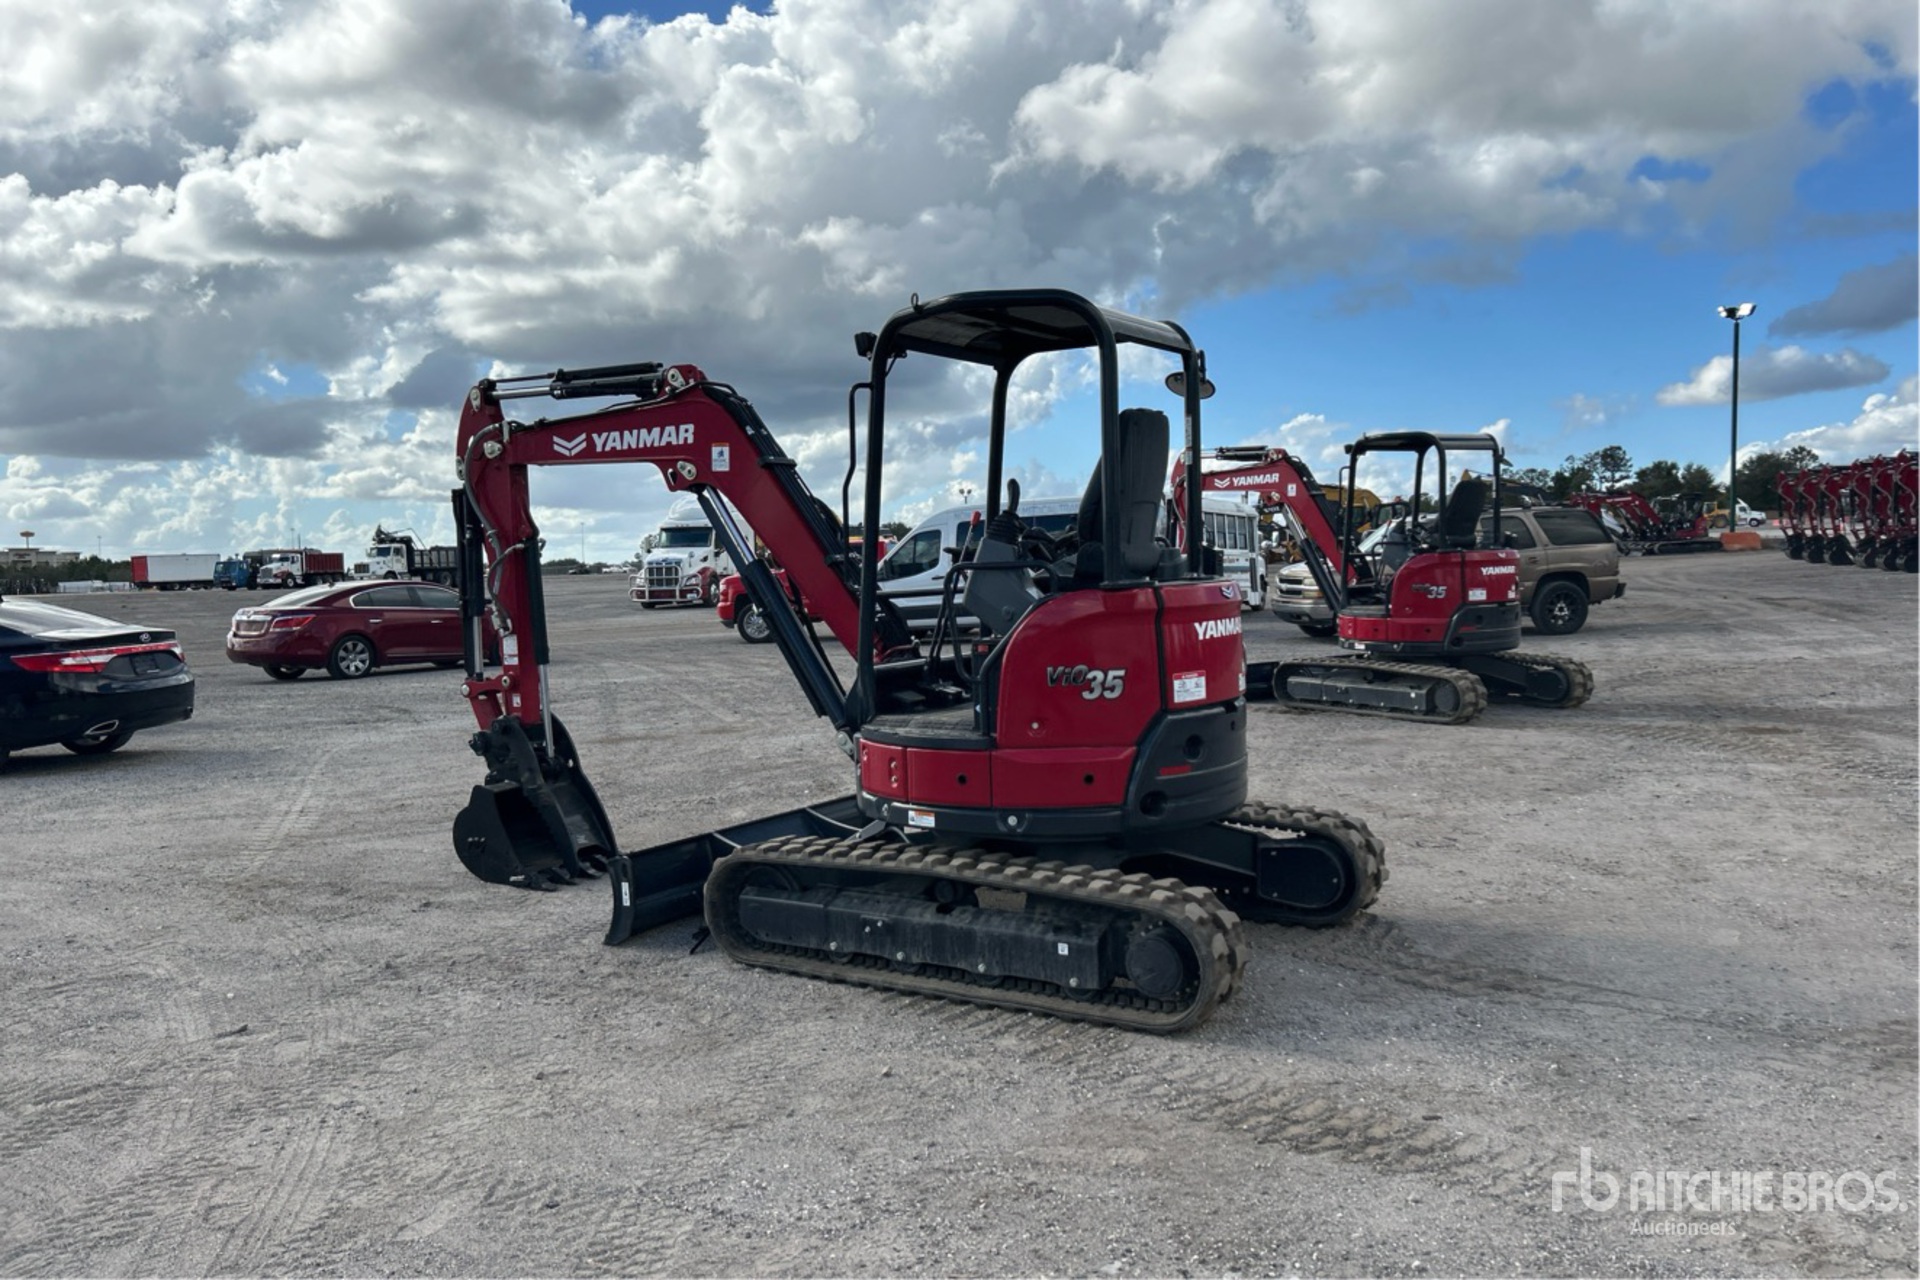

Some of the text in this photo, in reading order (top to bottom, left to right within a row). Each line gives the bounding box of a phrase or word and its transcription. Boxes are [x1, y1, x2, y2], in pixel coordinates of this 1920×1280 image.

[591, 424, 694, 452] YANMAR
[1232, 473, 1279, 487] YANMAR
[1194, 616, 1241, 640] YANMA
